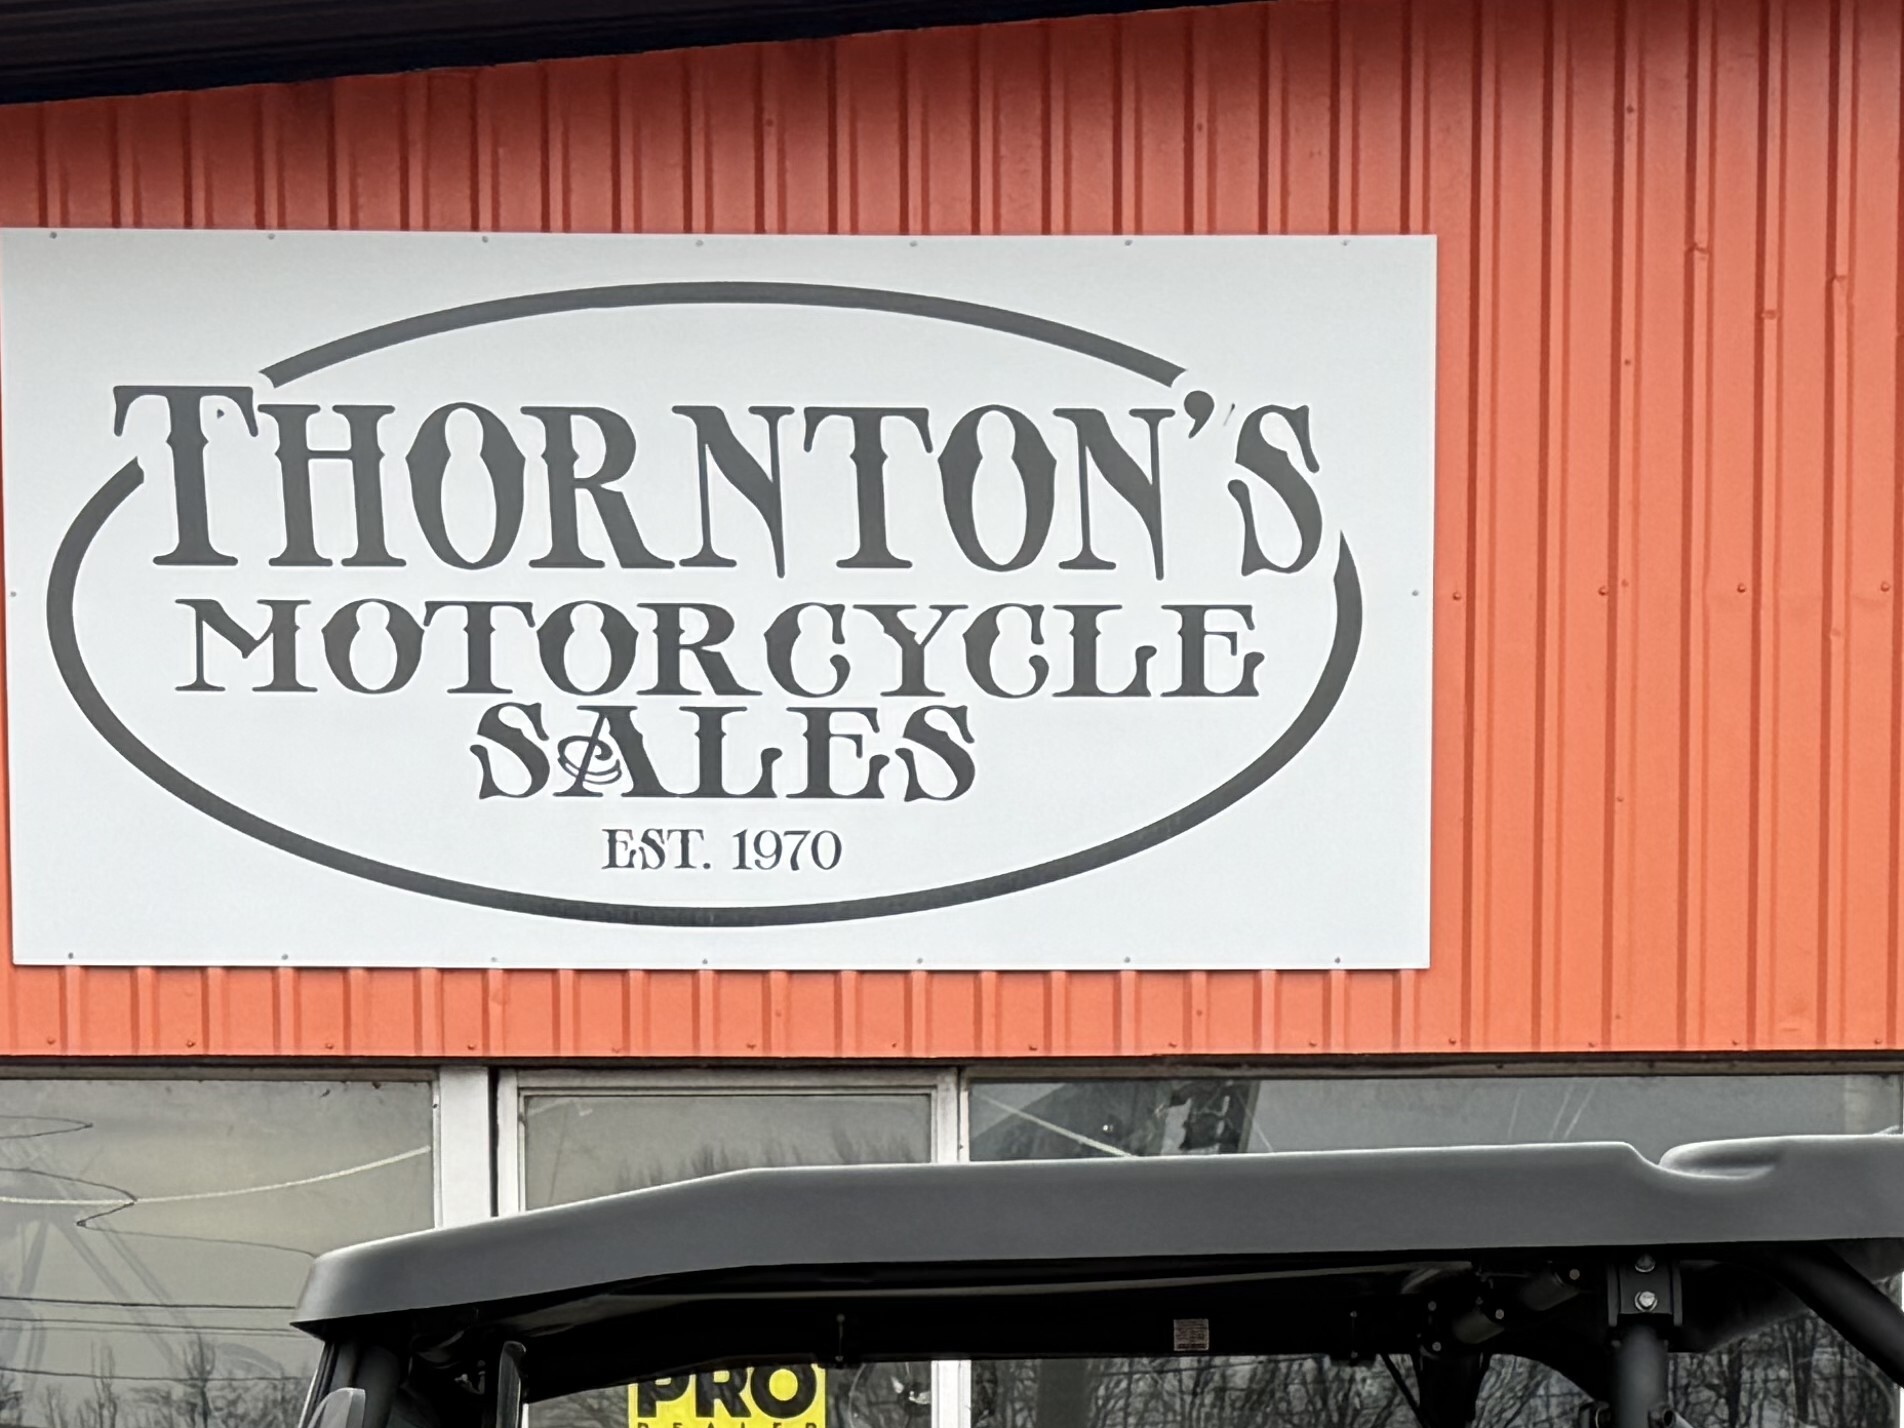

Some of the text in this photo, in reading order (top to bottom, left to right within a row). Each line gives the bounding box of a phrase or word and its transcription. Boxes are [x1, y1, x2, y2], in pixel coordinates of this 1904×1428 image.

[112, 385, 1324, 580] THORNTON'S
[174, 598, 1265, 699] MOTORCYCLE
[469, 702, 976, 803] SALES
[601, 828, 843, 871] EST. 1970
[637, 1366, 817, 1419] PRO
